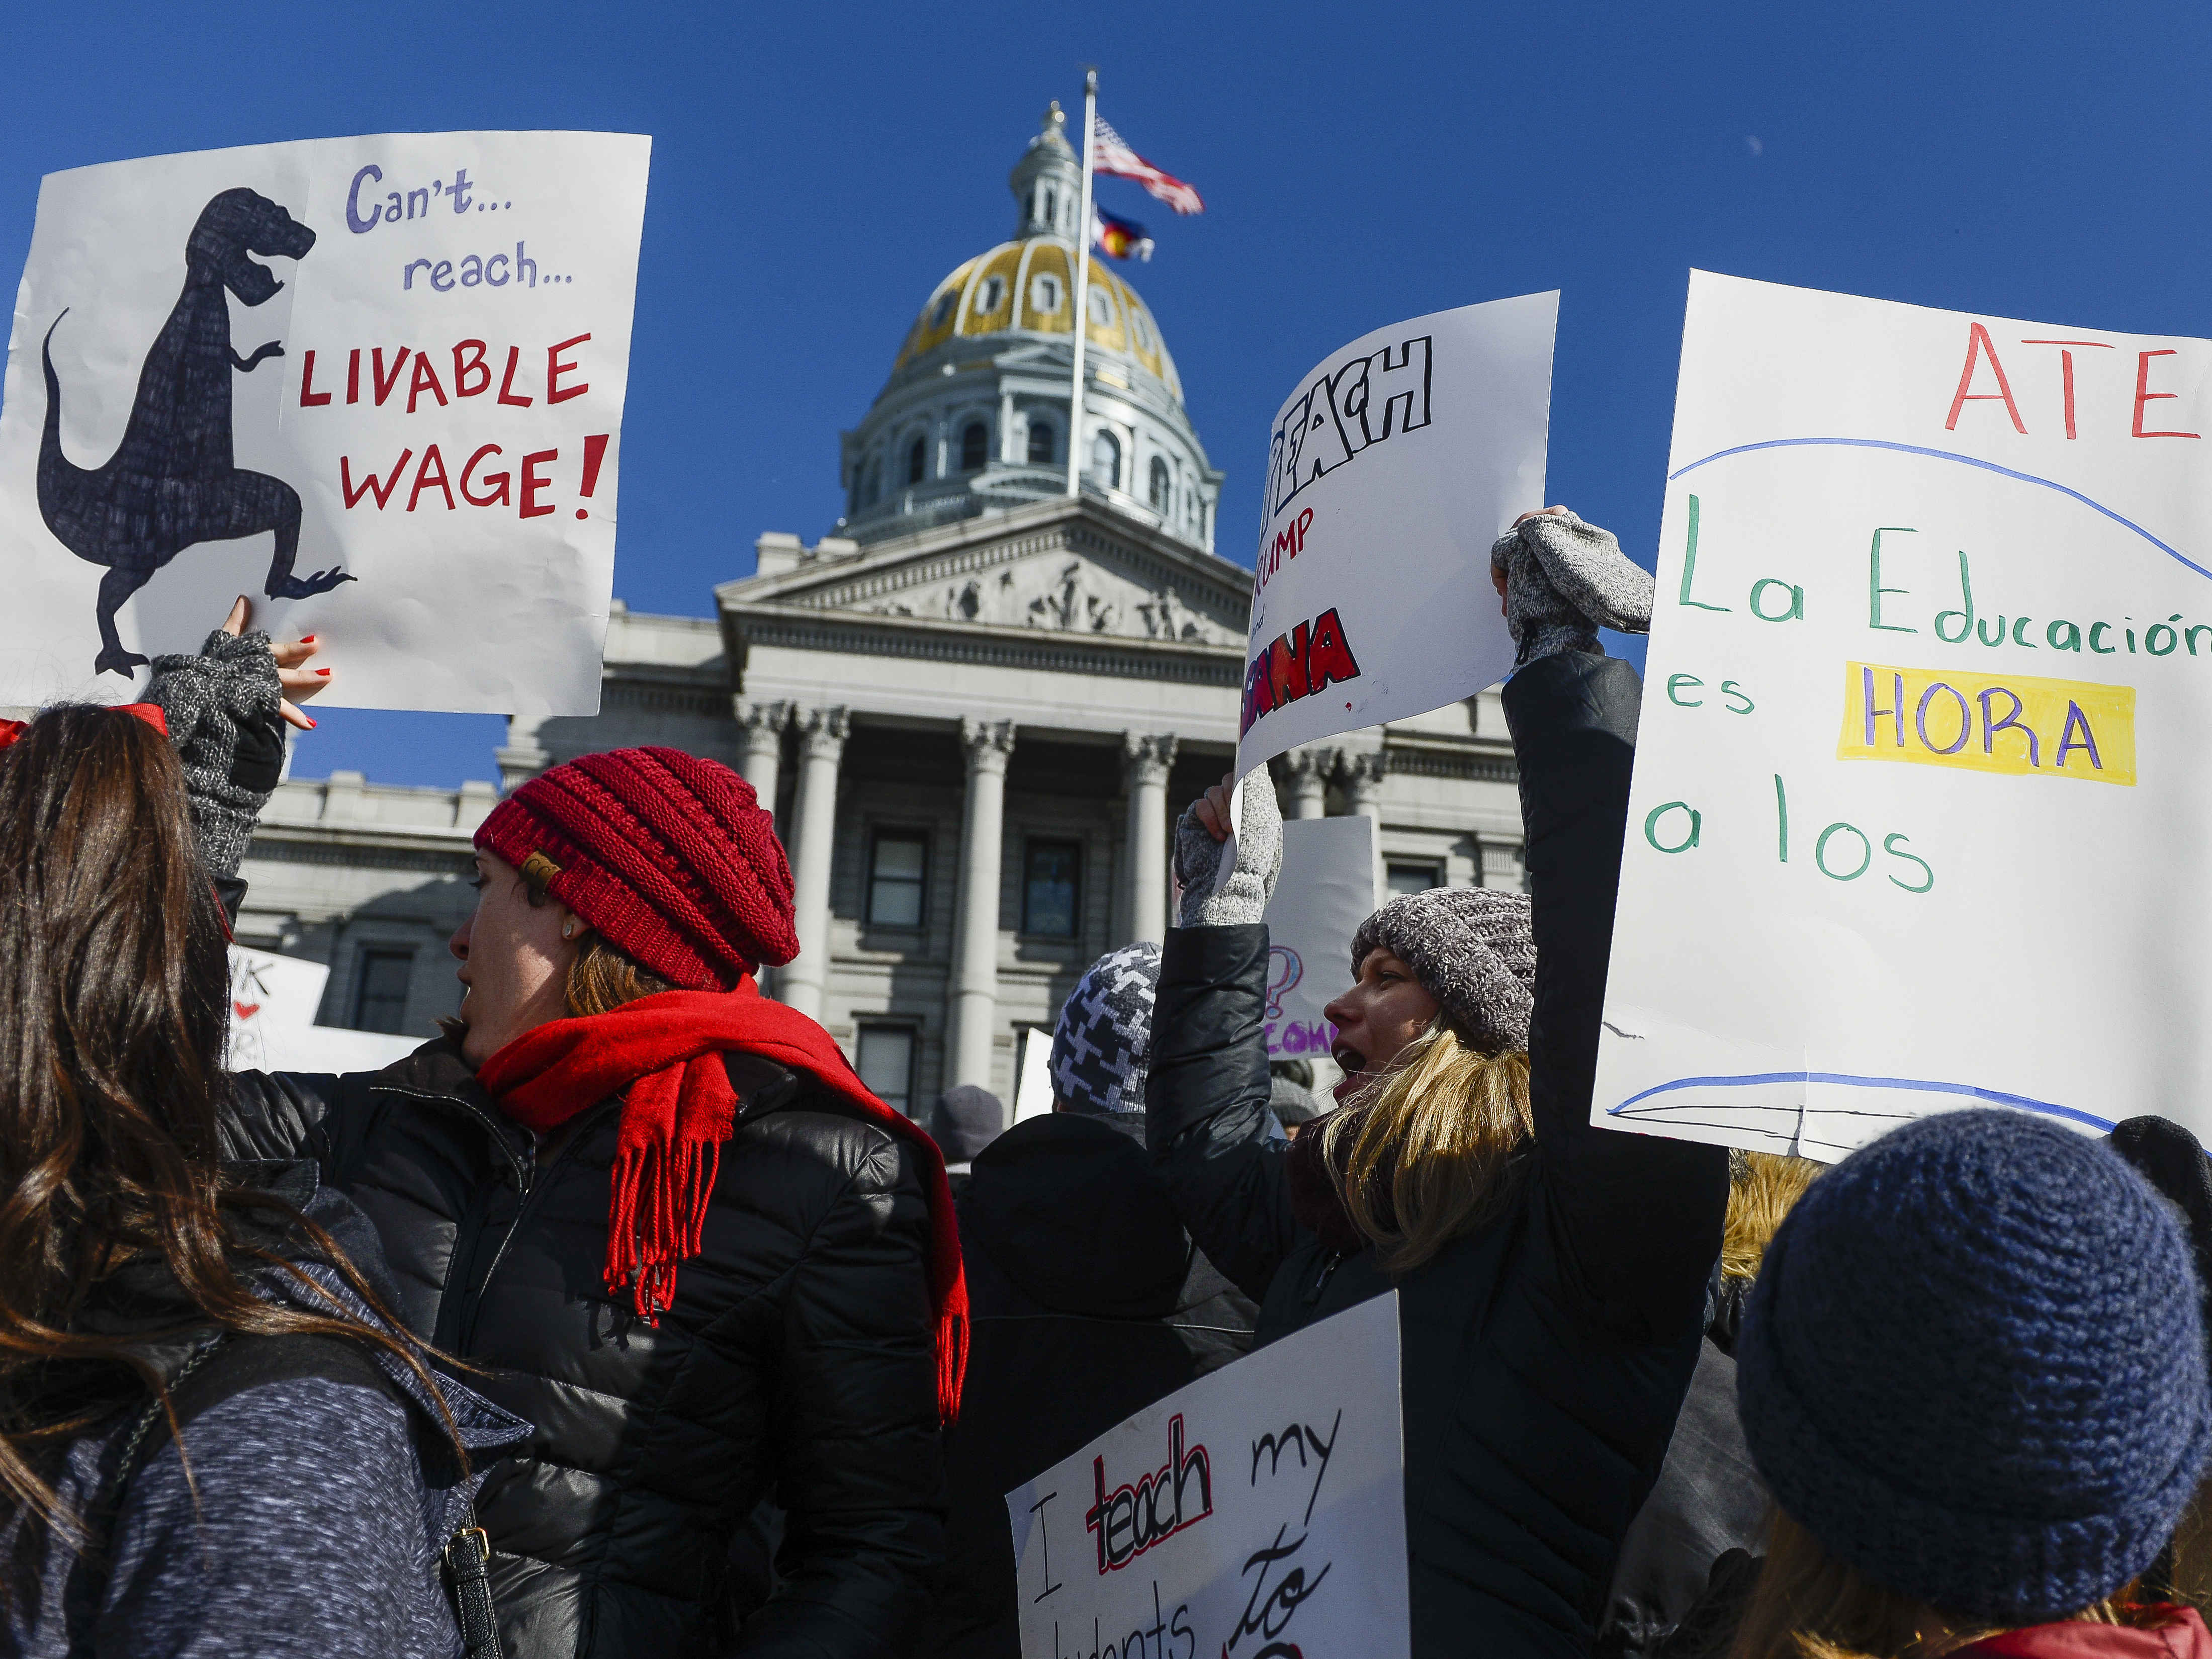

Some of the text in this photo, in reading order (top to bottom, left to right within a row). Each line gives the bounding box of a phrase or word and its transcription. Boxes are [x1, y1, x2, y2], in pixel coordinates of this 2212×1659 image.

[345, 164, 511, 233] Can't...
[404, 241, 572, 292] reach...
[300, 333, 591, 413] LIVABLE
[1945, 322, 2201, 439] ATE
[340, 434, 609, 520] WAGE!
[1679, 494, 1804, 622] La
[1667, 666, 2103, 770] es HORA
[1645, 774, 1934, 893] a los
[1029, 1409, 1342, 1604] I teach my
